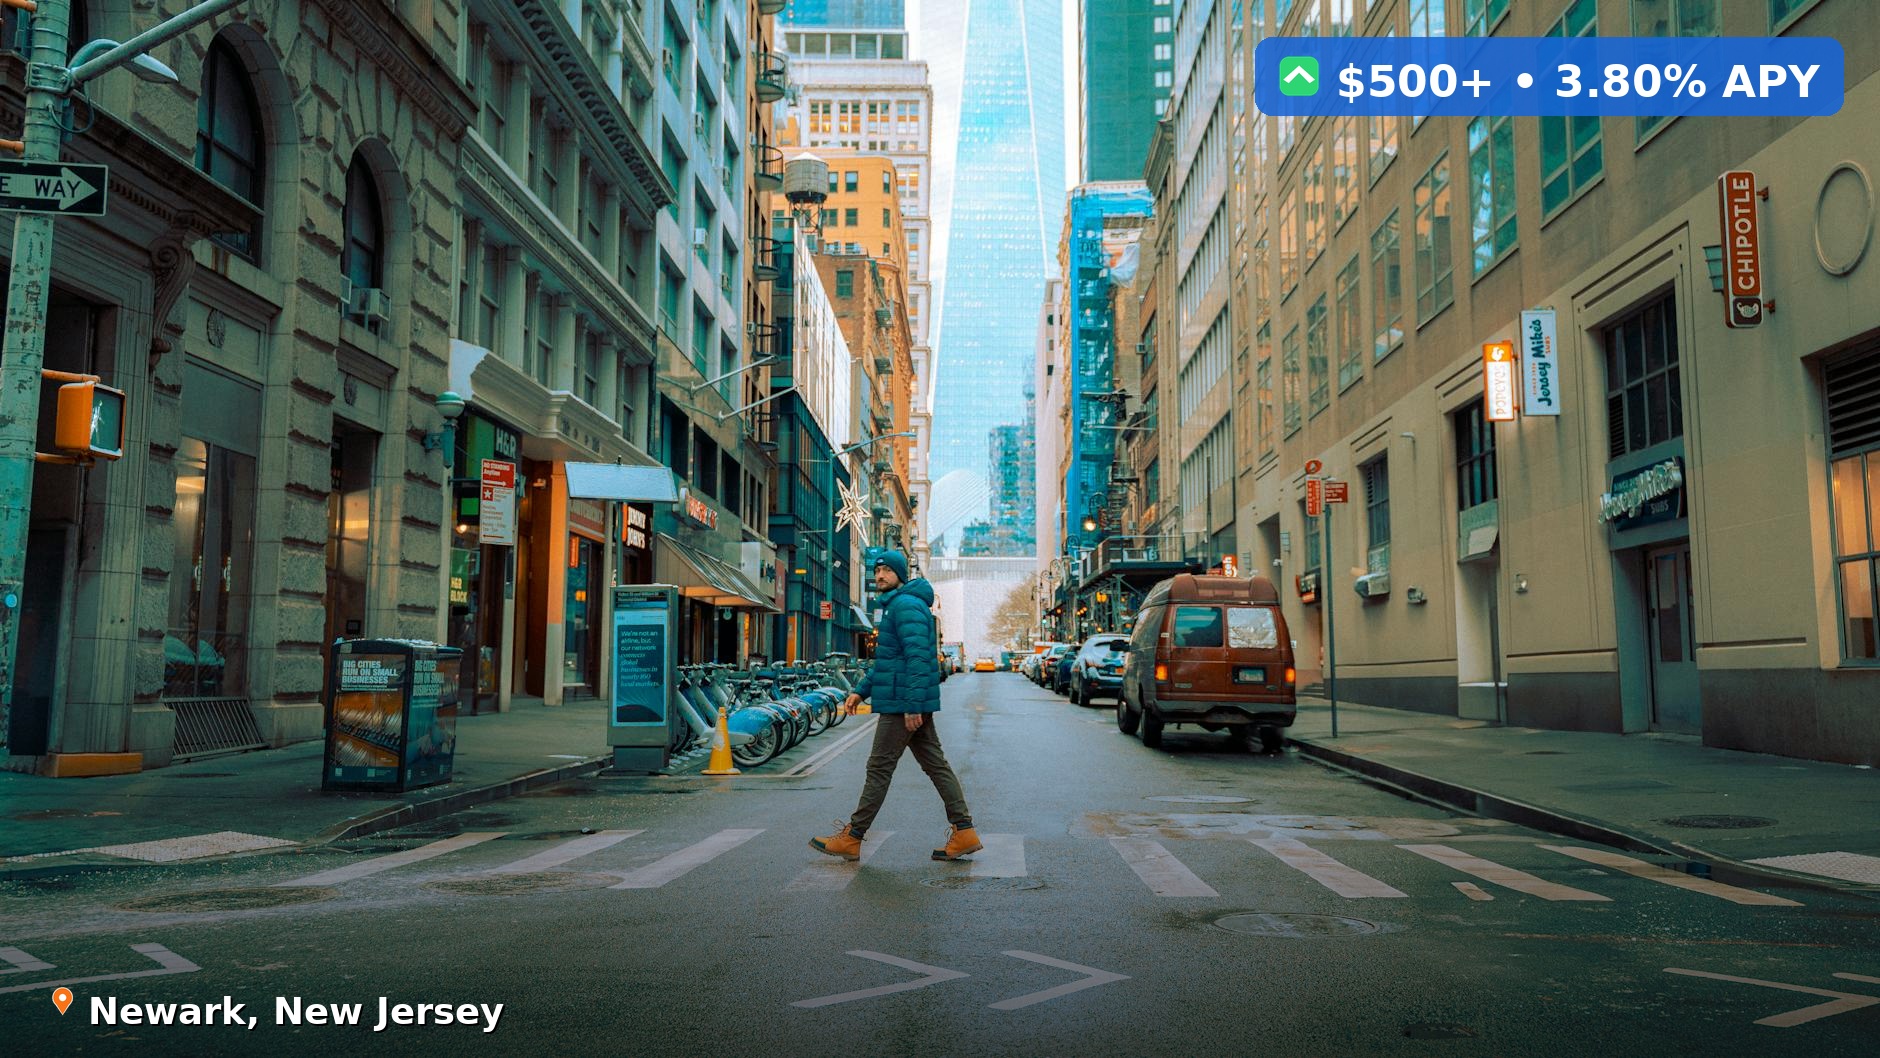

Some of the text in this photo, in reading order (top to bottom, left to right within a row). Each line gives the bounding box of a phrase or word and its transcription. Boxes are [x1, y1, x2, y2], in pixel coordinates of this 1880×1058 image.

[34, 178, 81, 198] WAY
[1732, 177, 1755, 290] CHIPOTLE
[1529, 319, 1552, 406] Jersey Mike's
[495, 427, 516, 459] H&R
[342, 667, 398, 676] RUN ON SMALL
[343, 660, 382, 668] BIG CITIES
[342, 675, 389, 684] BUSINESSES
